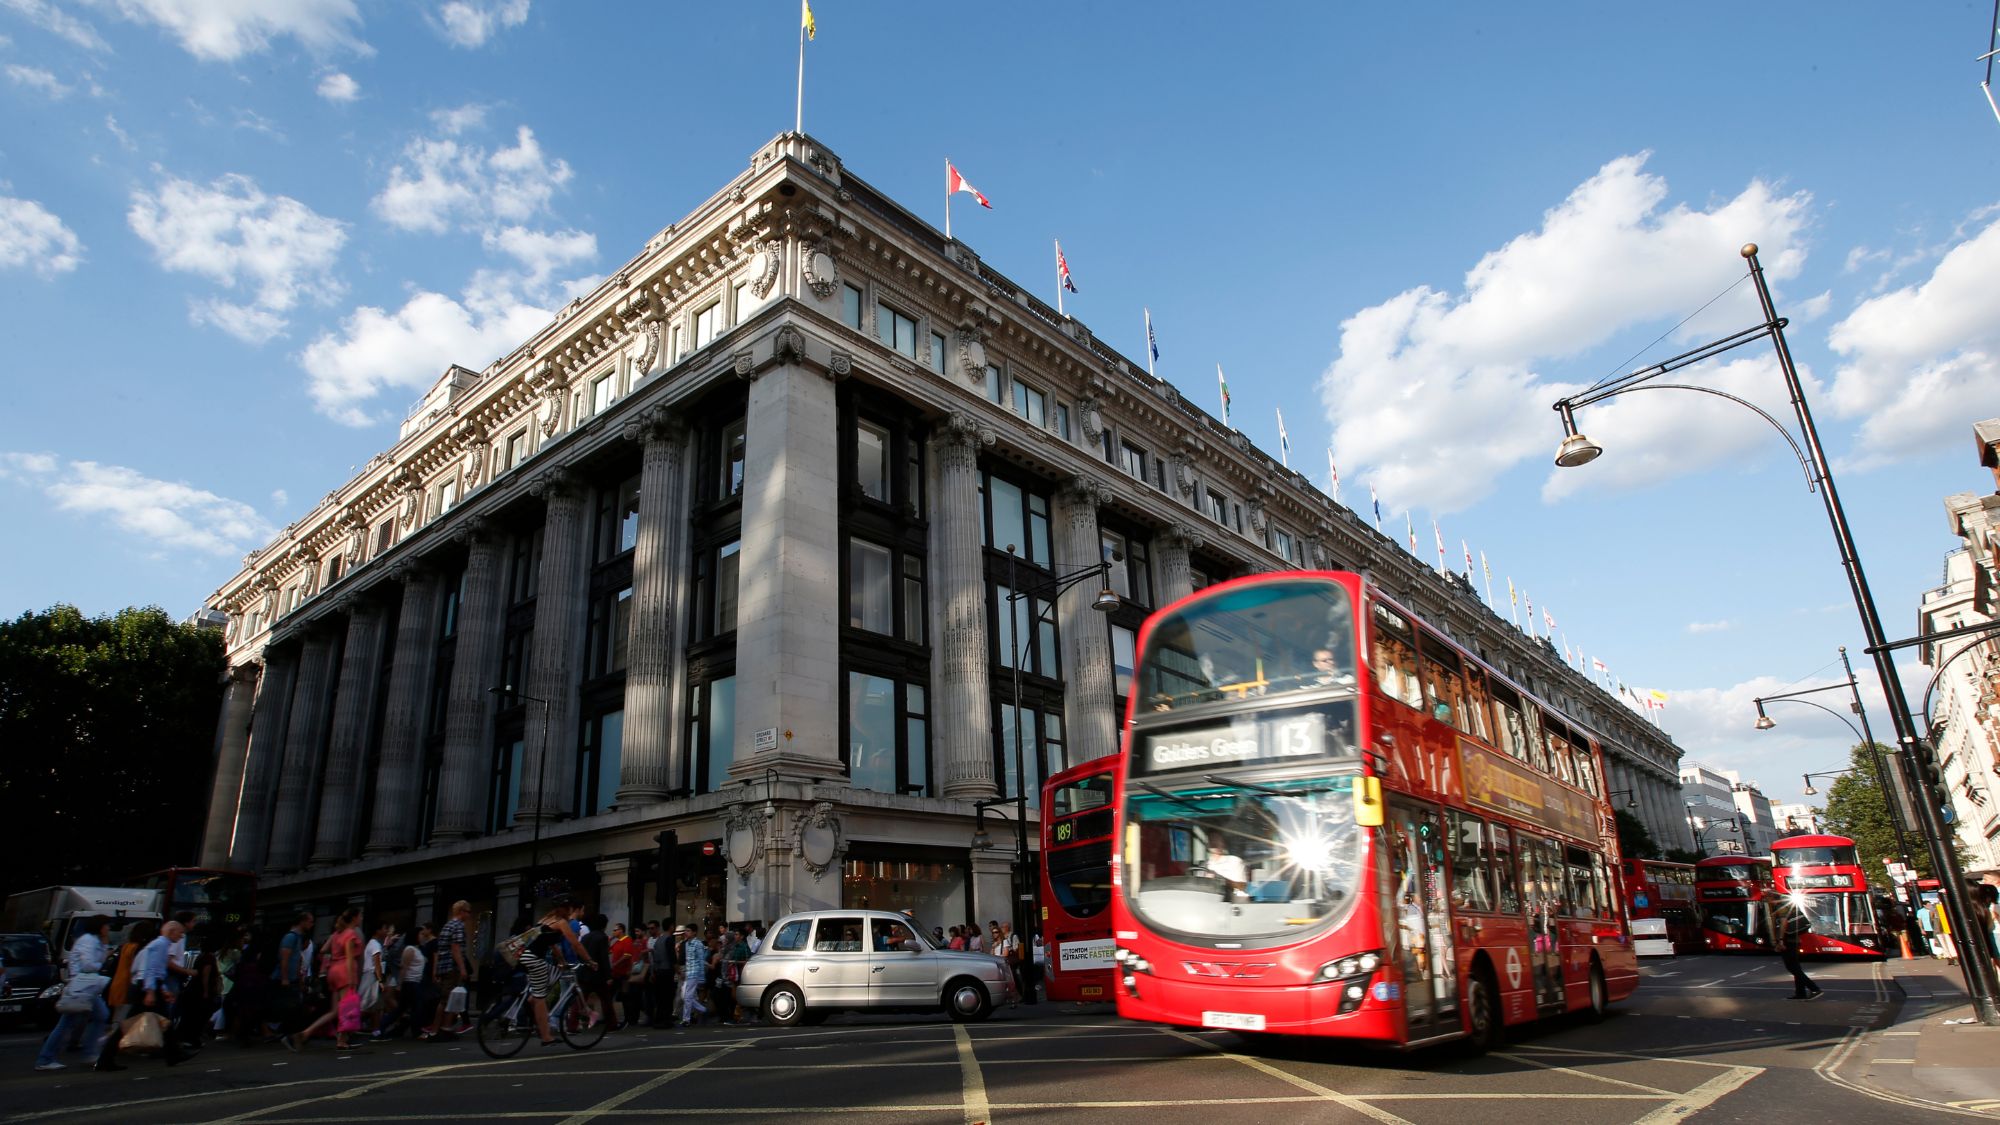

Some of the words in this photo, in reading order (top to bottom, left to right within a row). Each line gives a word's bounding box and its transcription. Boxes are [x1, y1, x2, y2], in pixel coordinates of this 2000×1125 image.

[1281, 721, 1312, 755] 13
[1153, 743, 1210, 763] Golders
[1211, 738, 1258, 757] Green
[1057, 823, 1071, 841] 189
[1834, 875, 1849, 886] 390
[95, 899, 136, 907] Sunlight
[225, 913, 241, 923] 139
[1069, 953, 1089, 961] TRAFFIC
[1089, 949, 1115, 959] FASTER
